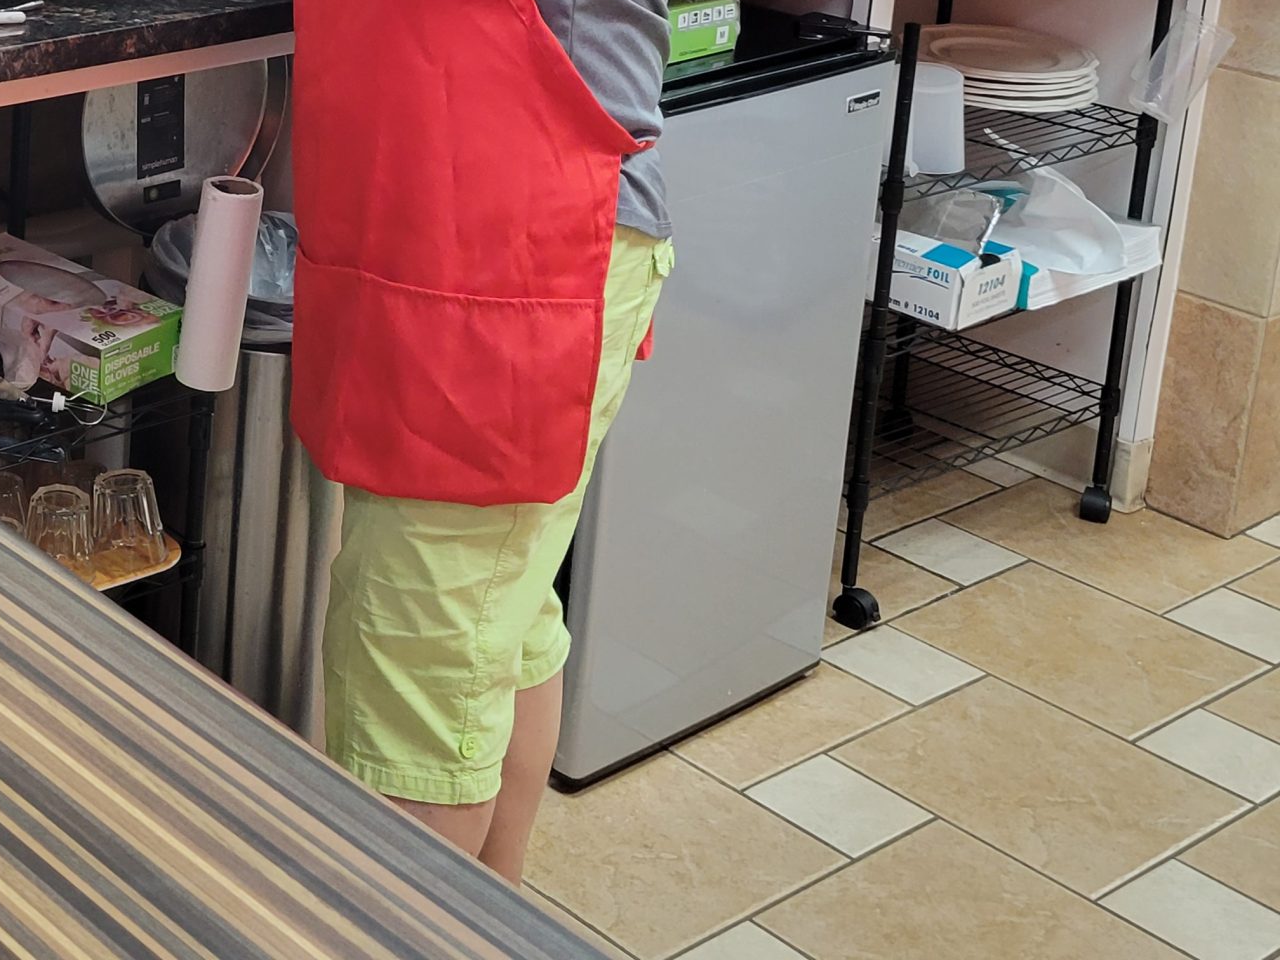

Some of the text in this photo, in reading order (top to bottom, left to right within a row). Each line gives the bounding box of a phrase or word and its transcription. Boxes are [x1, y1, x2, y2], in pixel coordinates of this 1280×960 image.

[926, 266, 950, 284] FOIL
[978, 274, 1006, 296] 12104
[913, 303, 941, 321] 12104
[92, 330, 117, 344] 500
[104, 342, 161, 375] DISPOSABLE
[71, 362, 99, 380] ONE
[104, 362, 140, 386] GLOVES
[71, 374, 99, 395] SIZE
